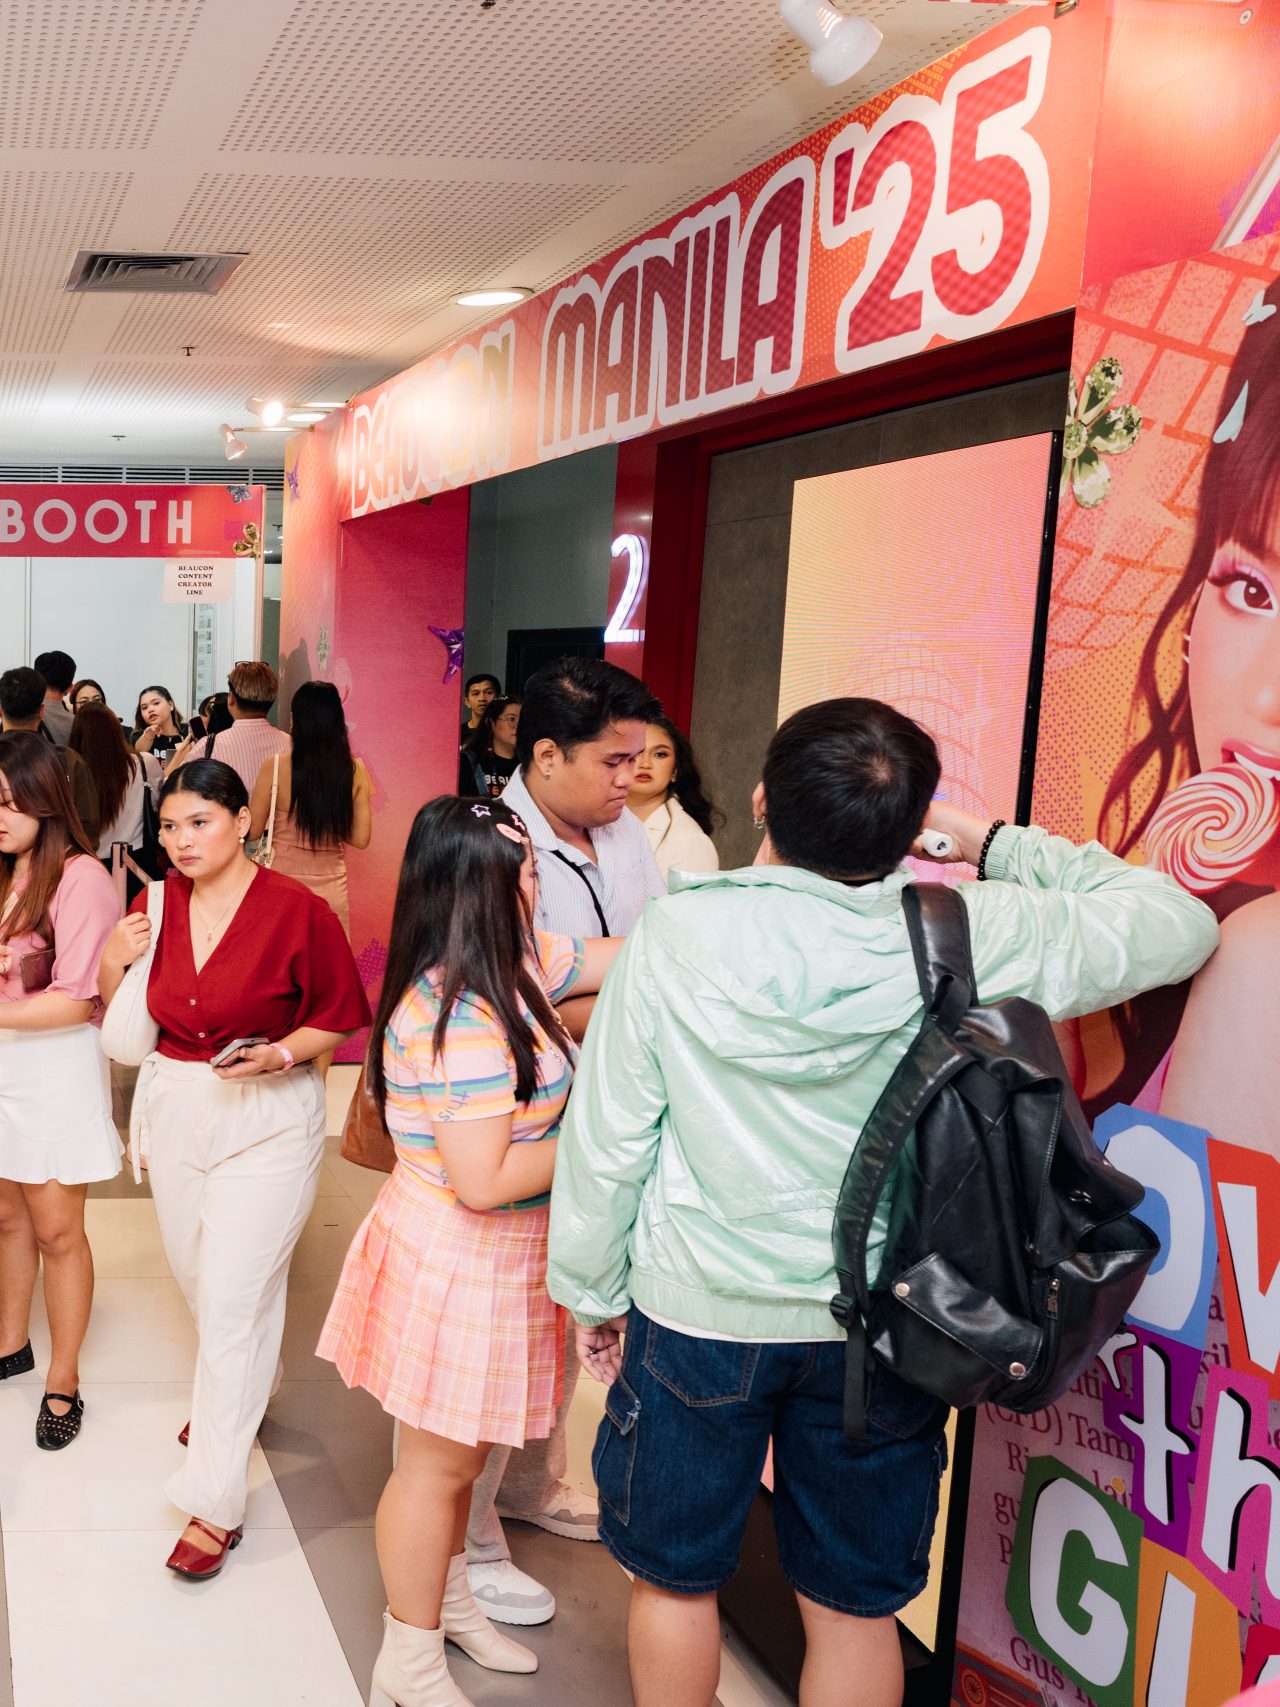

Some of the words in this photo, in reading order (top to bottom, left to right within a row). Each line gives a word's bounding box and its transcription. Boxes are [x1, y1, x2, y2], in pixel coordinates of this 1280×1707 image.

[540, 165, 812, 455] MANILA
[826, 38, 1042, 362] '25
[0, 499, 192, 544] BOOTH
[604, 533, 645, 643] 2
[1010, 1636, 1065, 1691] Gus
